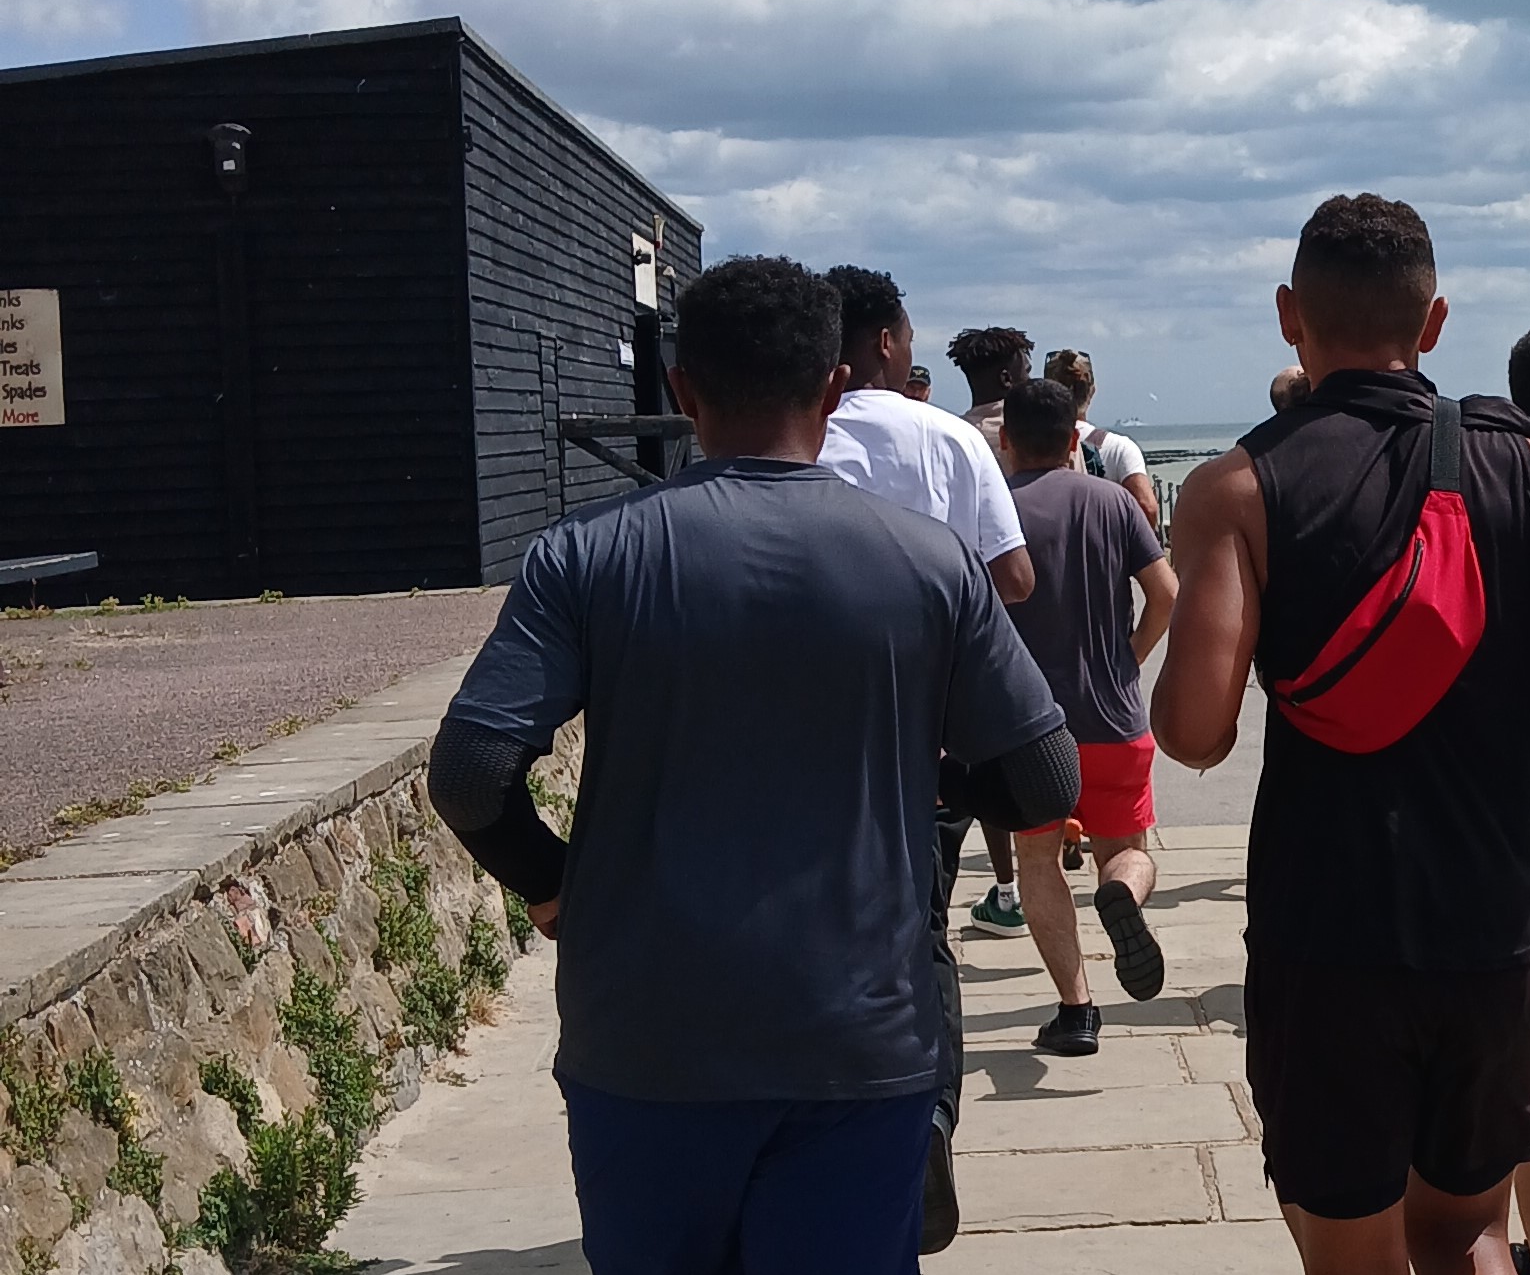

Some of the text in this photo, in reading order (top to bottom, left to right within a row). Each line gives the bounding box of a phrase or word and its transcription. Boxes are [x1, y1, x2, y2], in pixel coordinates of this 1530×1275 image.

[0, 313, 25, 331] nks
[0, 360, 41, 375] Treats
[2, 381, 47, 404] Spades
[2, 408, 40, 424] More
